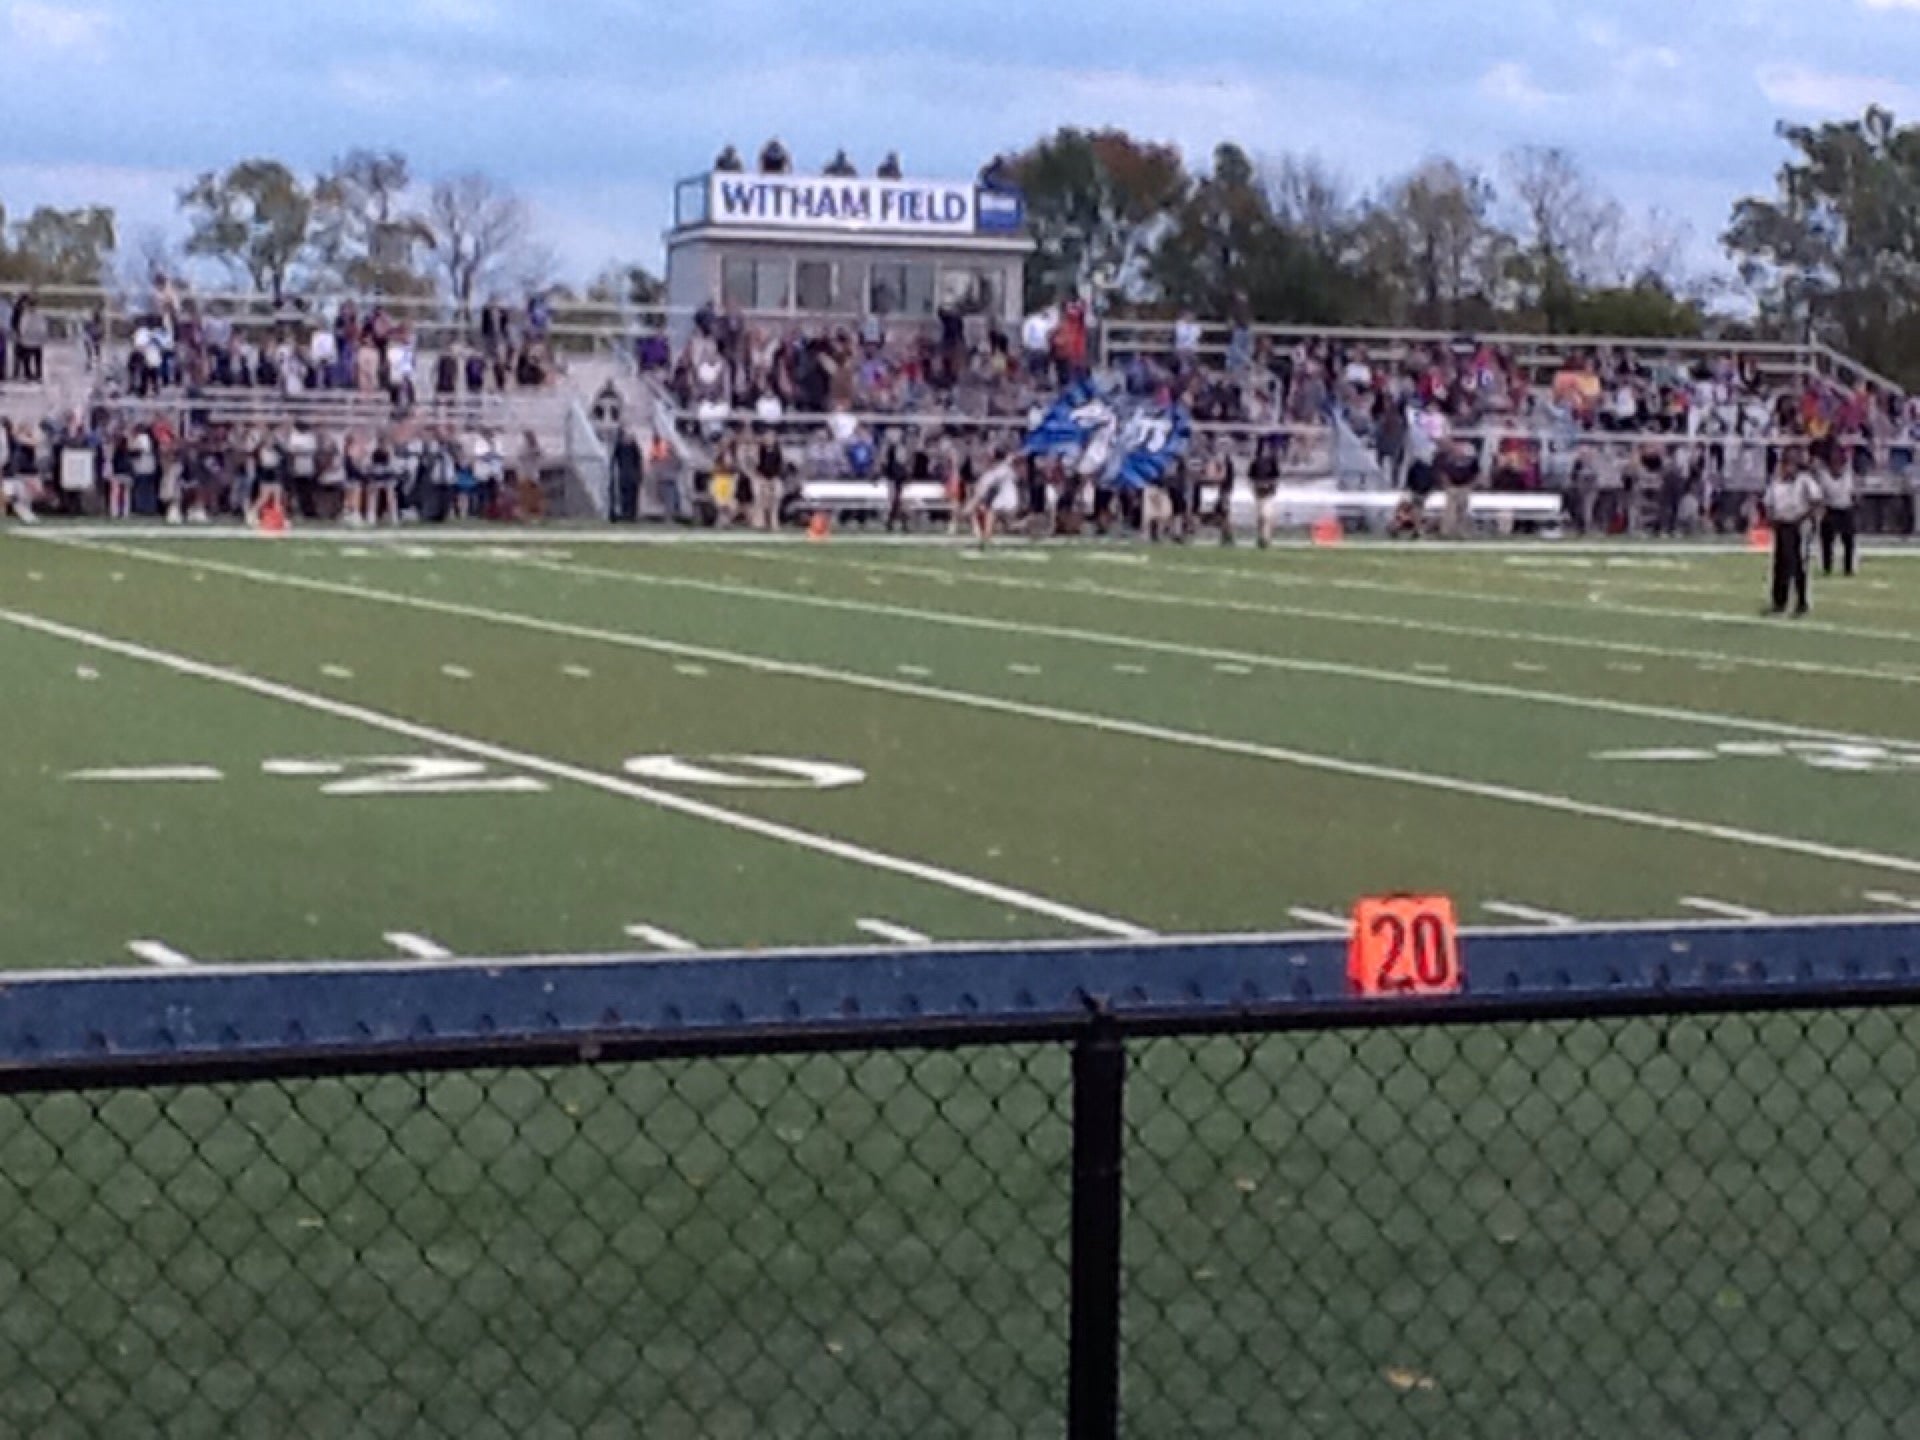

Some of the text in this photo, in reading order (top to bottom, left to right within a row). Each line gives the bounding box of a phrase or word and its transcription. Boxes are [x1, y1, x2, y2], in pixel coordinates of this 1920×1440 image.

[719, 181, 870, 220] WITHAM
[881, 187, 967, 223] FIELD
[1371, 914, 1448, 990] 20
